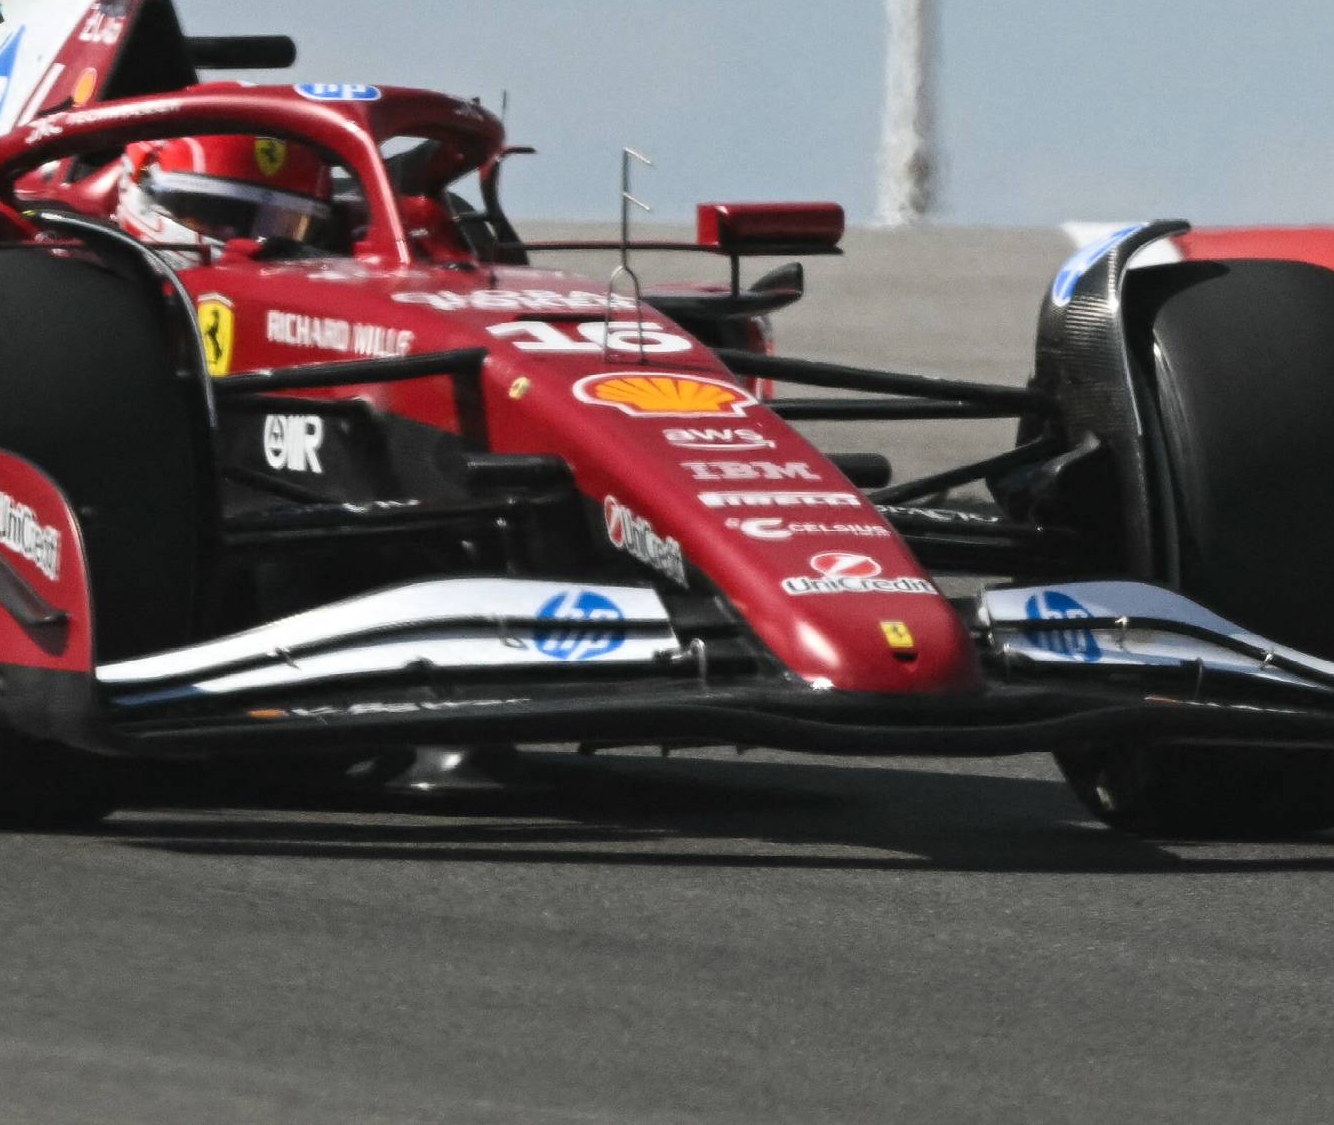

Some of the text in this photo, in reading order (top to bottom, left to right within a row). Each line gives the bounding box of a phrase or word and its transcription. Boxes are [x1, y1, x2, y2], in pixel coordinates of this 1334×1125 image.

[267, 309, 349, 352] RICHARD
[486, 320, 692, 353] 16
[679, 461, 821, 480] IBM
[784, 577, 936, 594] UniCredit
[542, 589, 619, 661] hp
